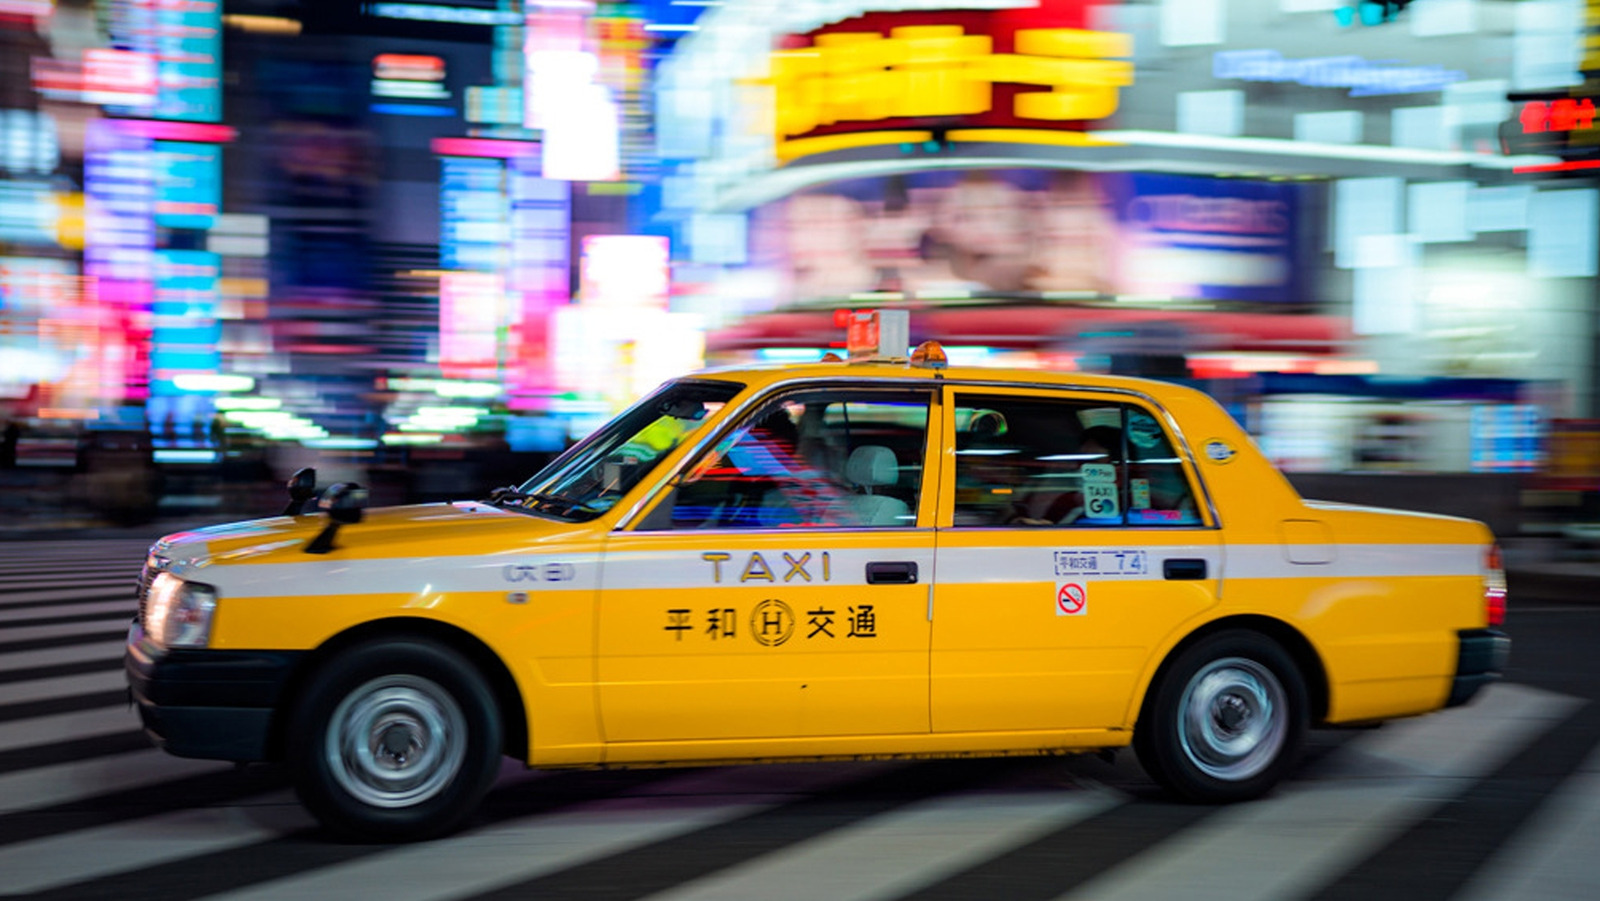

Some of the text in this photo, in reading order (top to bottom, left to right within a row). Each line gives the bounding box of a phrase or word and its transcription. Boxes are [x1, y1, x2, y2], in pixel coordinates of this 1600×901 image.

[1088, 486, 1114, 497] TAXI
[1089, 498, 1115, 514] GO
[702, 551, 831, 582] TAXI
[1115, 554, 1142, 570] 74
[664, 608, 737, 641] 平和
[806, 605, 877, 639] 交通
